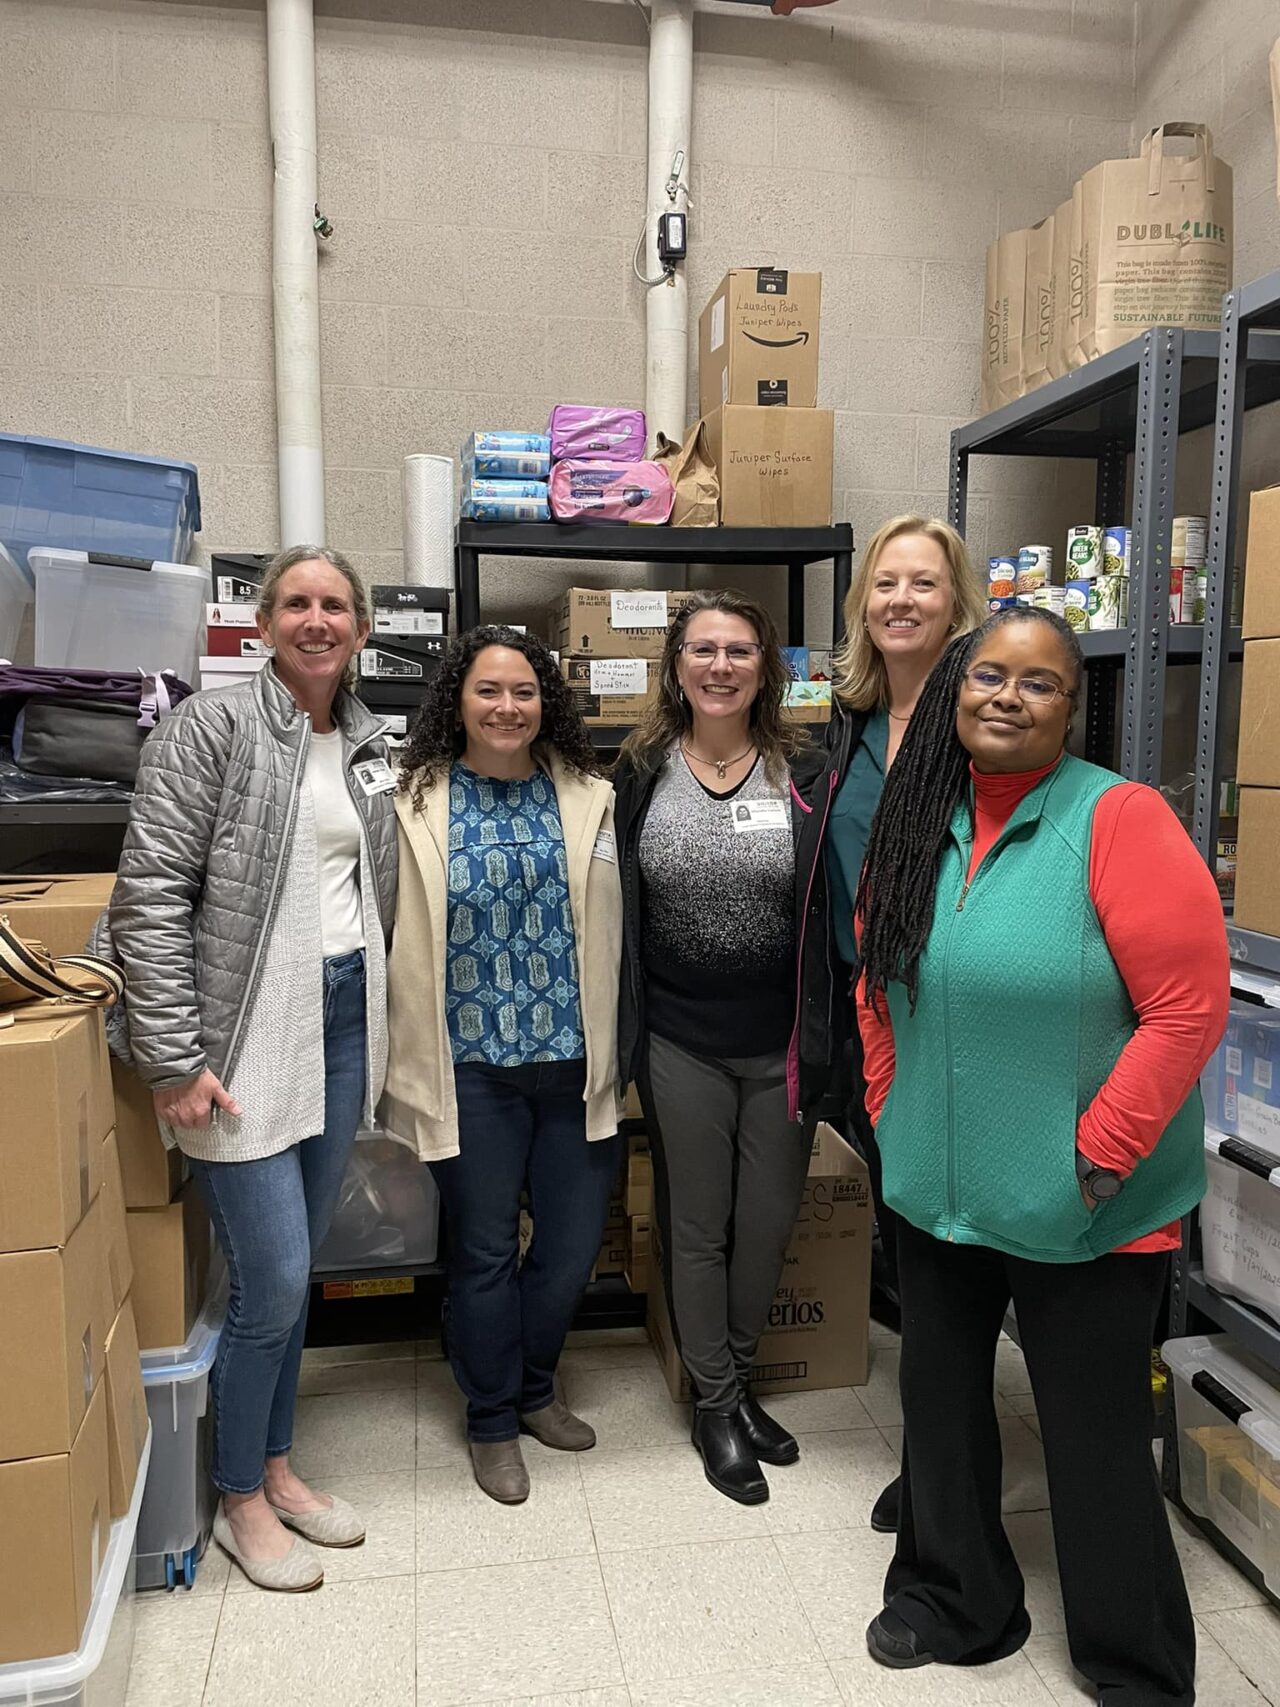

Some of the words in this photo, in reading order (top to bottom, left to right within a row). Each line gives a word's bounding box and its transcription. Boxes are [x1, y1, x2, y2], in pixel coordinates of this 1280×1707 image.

[1117, 223, 1174, 241] DUBL
[1193, 222, 1226, 244] LIFE
[736, 294, 776, 316] Laundry
[778, 299, 799, 313] Pods
[739, 316, 774, 328] Juniper
[776, 317, 802, 329] Wipes
[1113, 313, 1185, 322] SUSTAINABLE
[988, 300, 1000, 370] 100%
[728, 450, 771, 466] Juniper
[774, 450, 813, 465] Surface
[240, 586, 252, 596] 8.5
[379, 658, 383, 667] 7
[833, 1184, 862, 1194] 18447
[768, 1301, 824, 1327] erios
